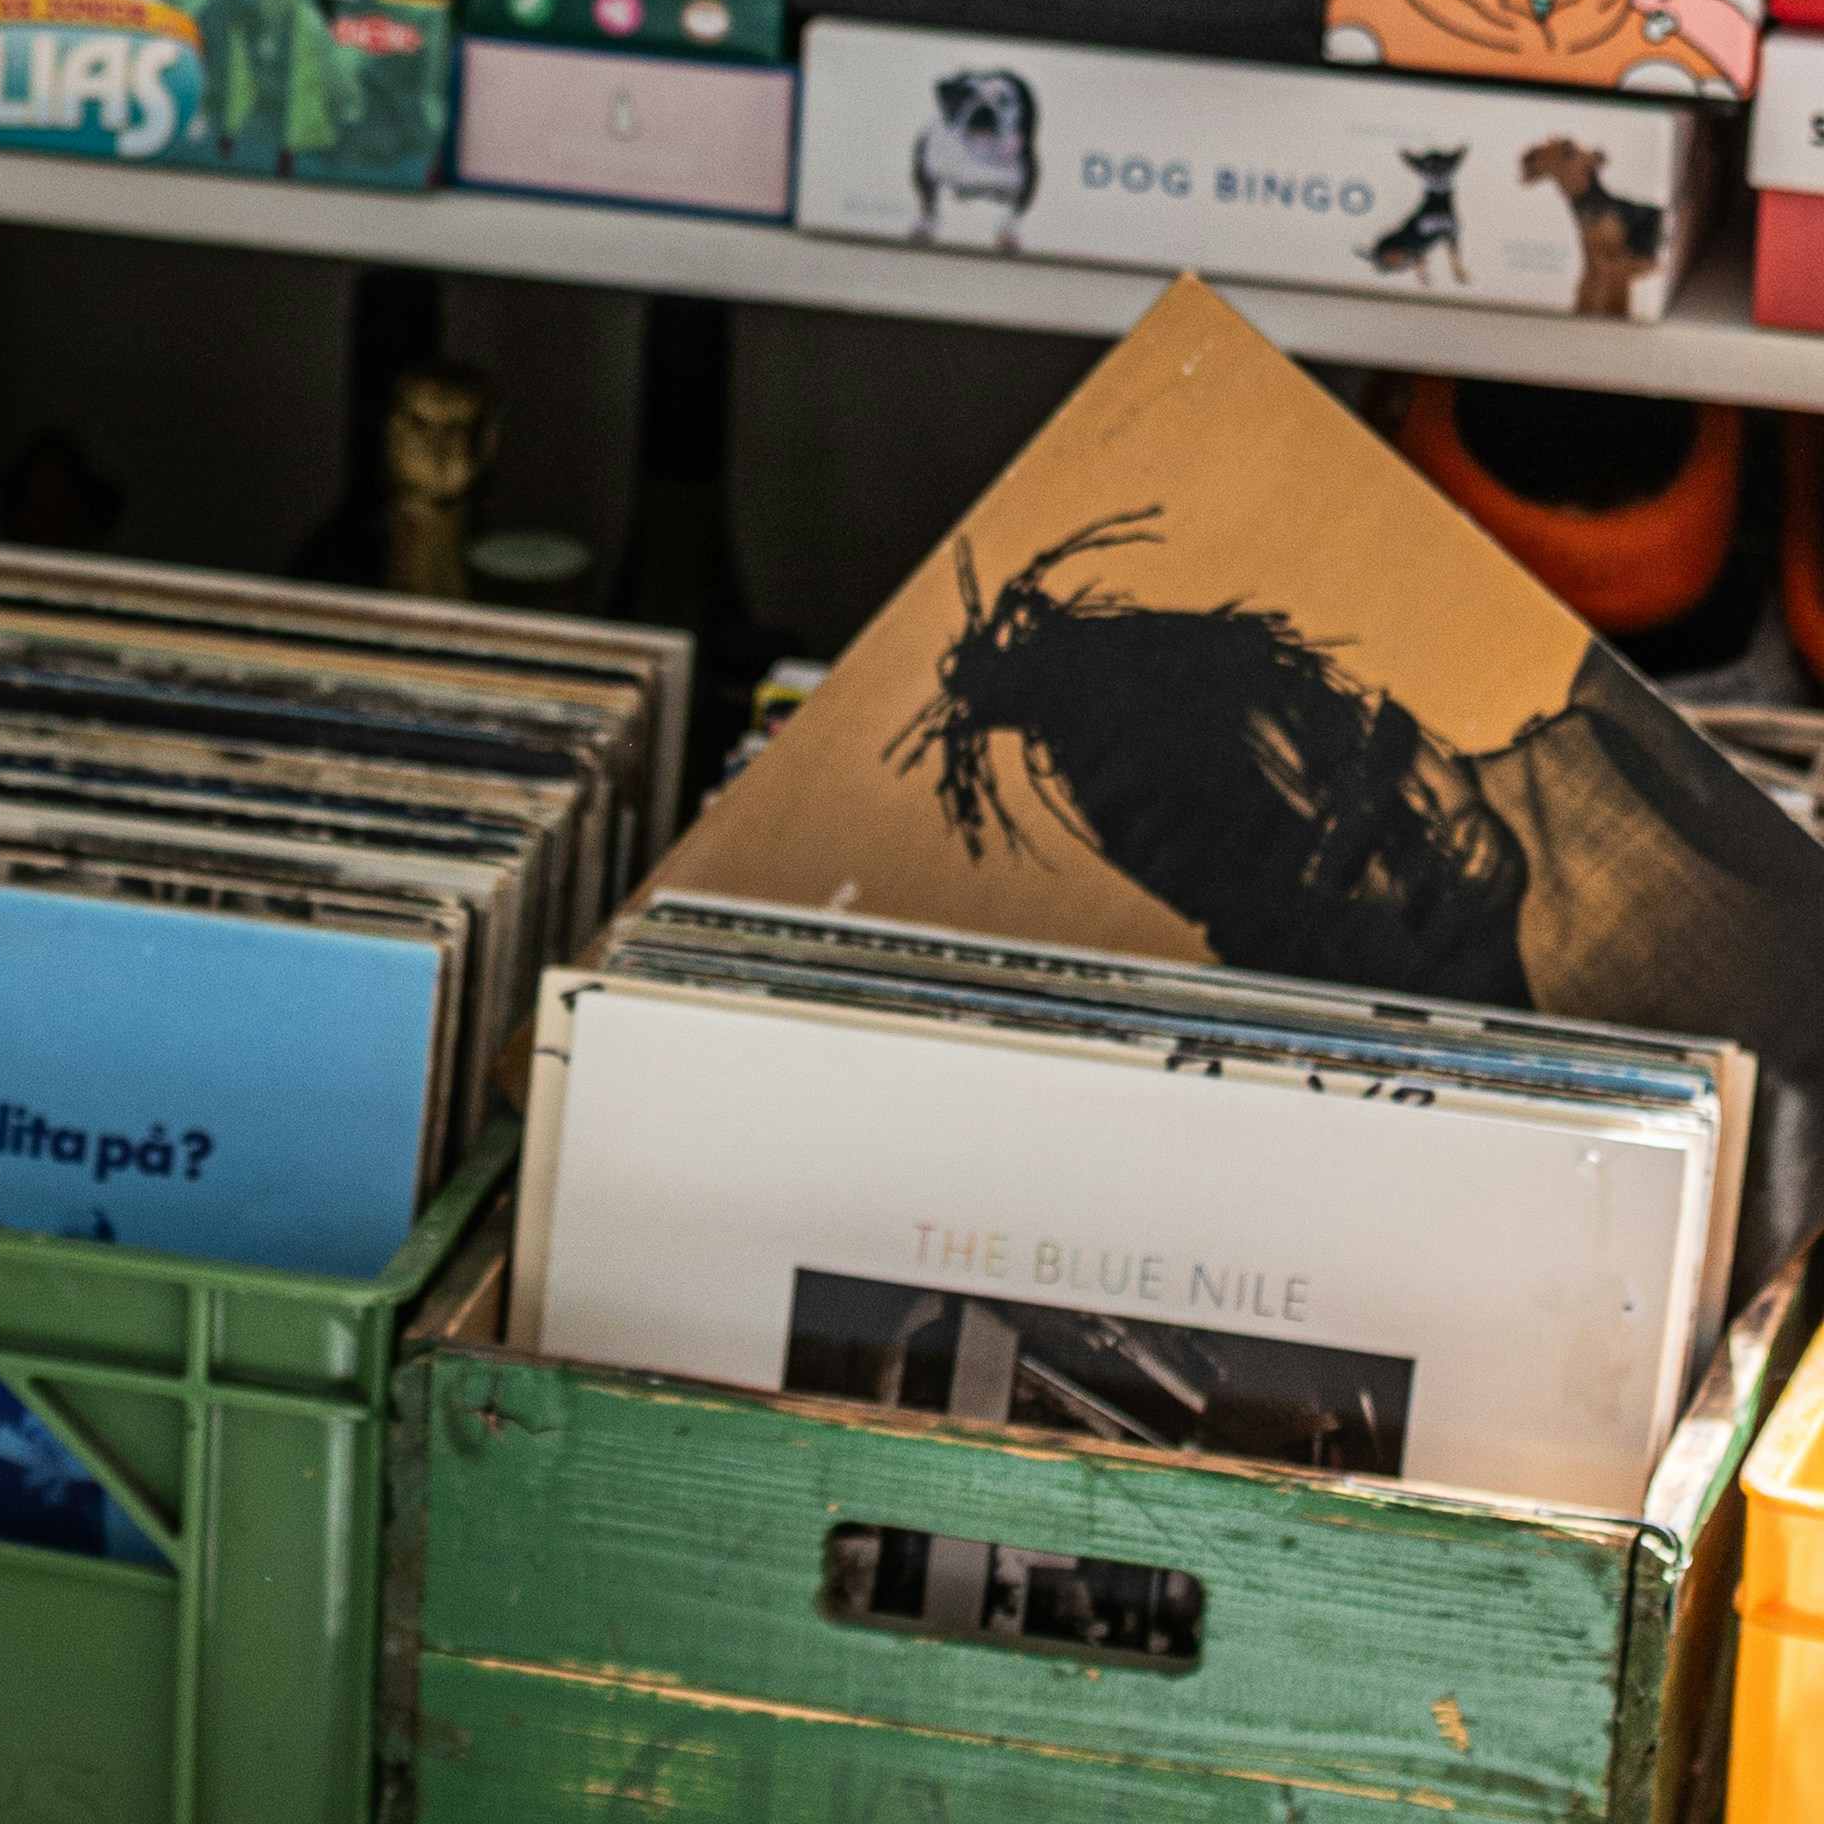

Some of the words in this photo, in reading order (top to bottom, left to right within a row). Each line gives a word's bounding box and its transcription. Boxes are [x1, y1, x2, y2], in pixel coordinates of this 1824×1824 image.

[1082, 152, 1194, 199] DOG
[1213, 163, 1376, 218] BINGO
[93, 1121, 216, 1184] på?
[913, 1221, 1009, 1280] THE
[1034, 1238, 1167, 1303] BLUE
[1189, 1262, 1312, 1324] NILE
